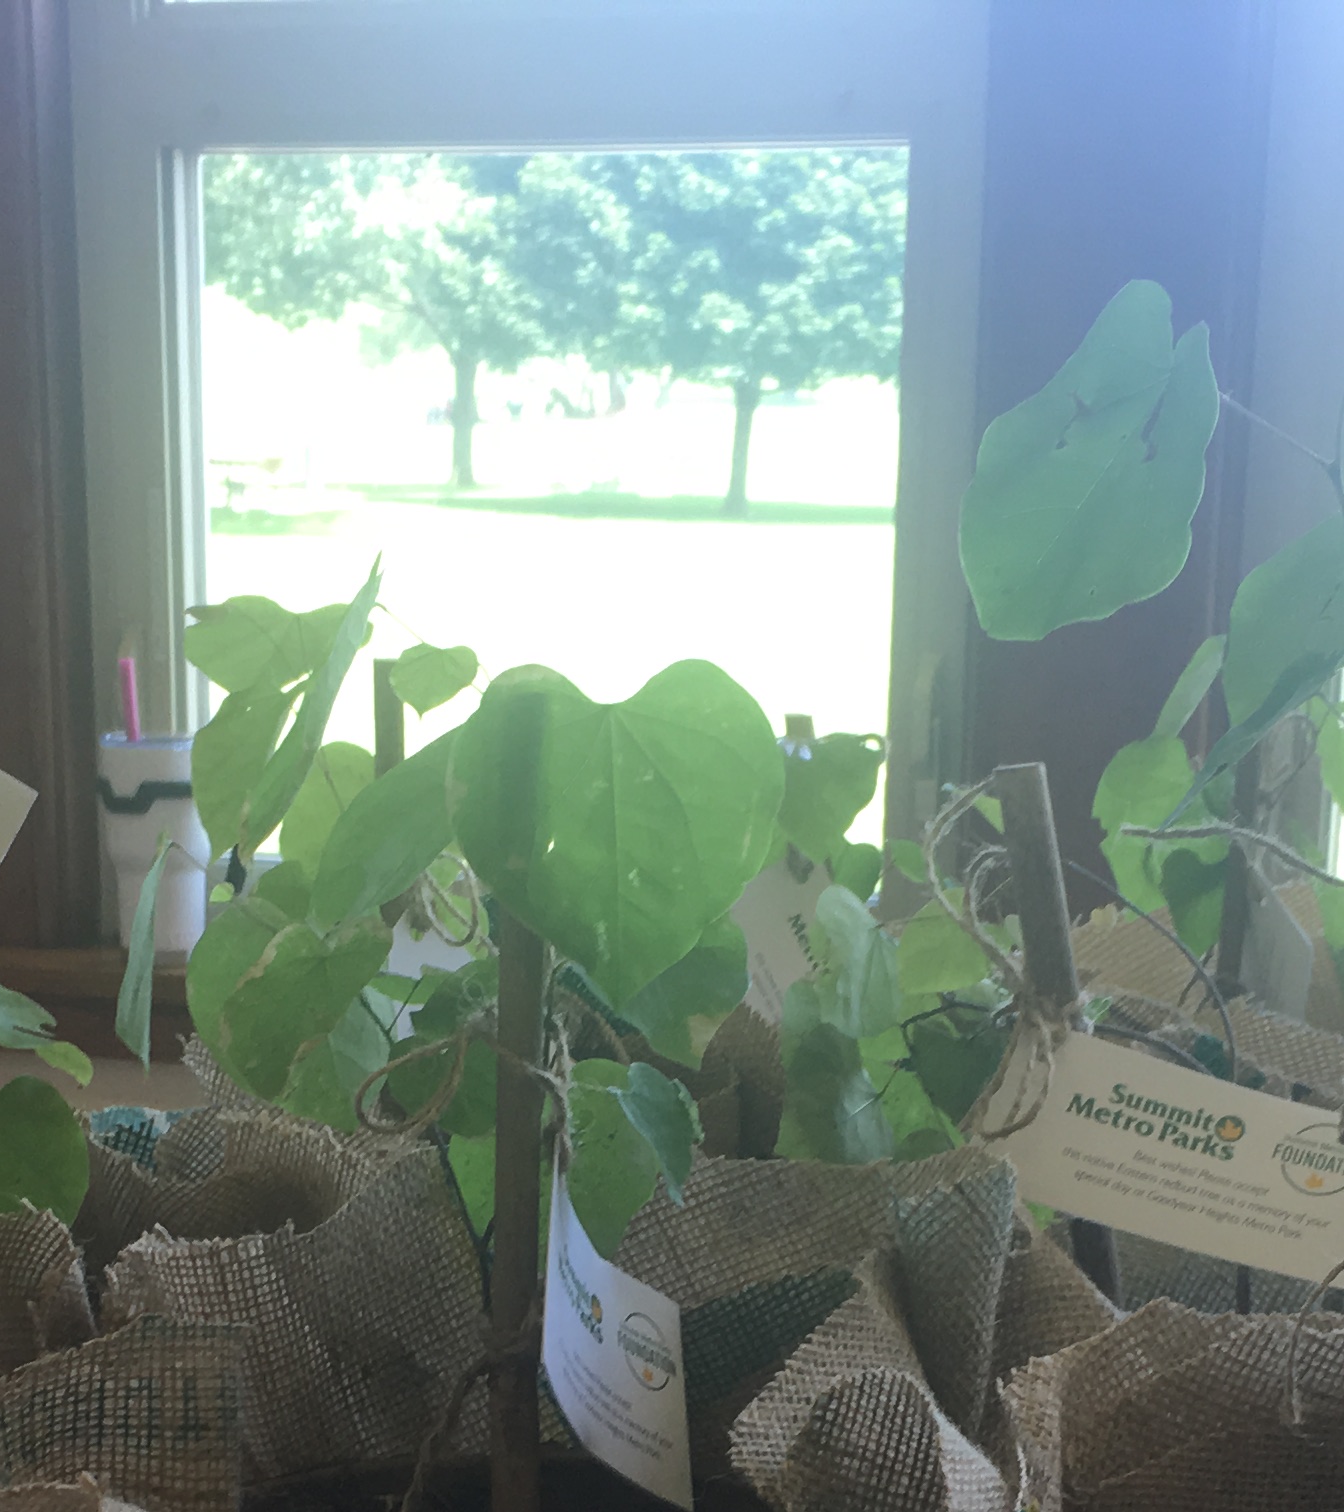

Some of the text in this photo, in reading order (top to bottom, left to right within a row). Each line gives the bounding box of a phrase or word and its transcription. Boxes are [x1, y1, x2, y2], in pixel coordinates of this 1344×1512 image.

[1065, 1093, 1154, 1136] Metro
[1158, 1121, 1235, 1161] Parks
[1108, 1083, 1215, 1132] Summit
